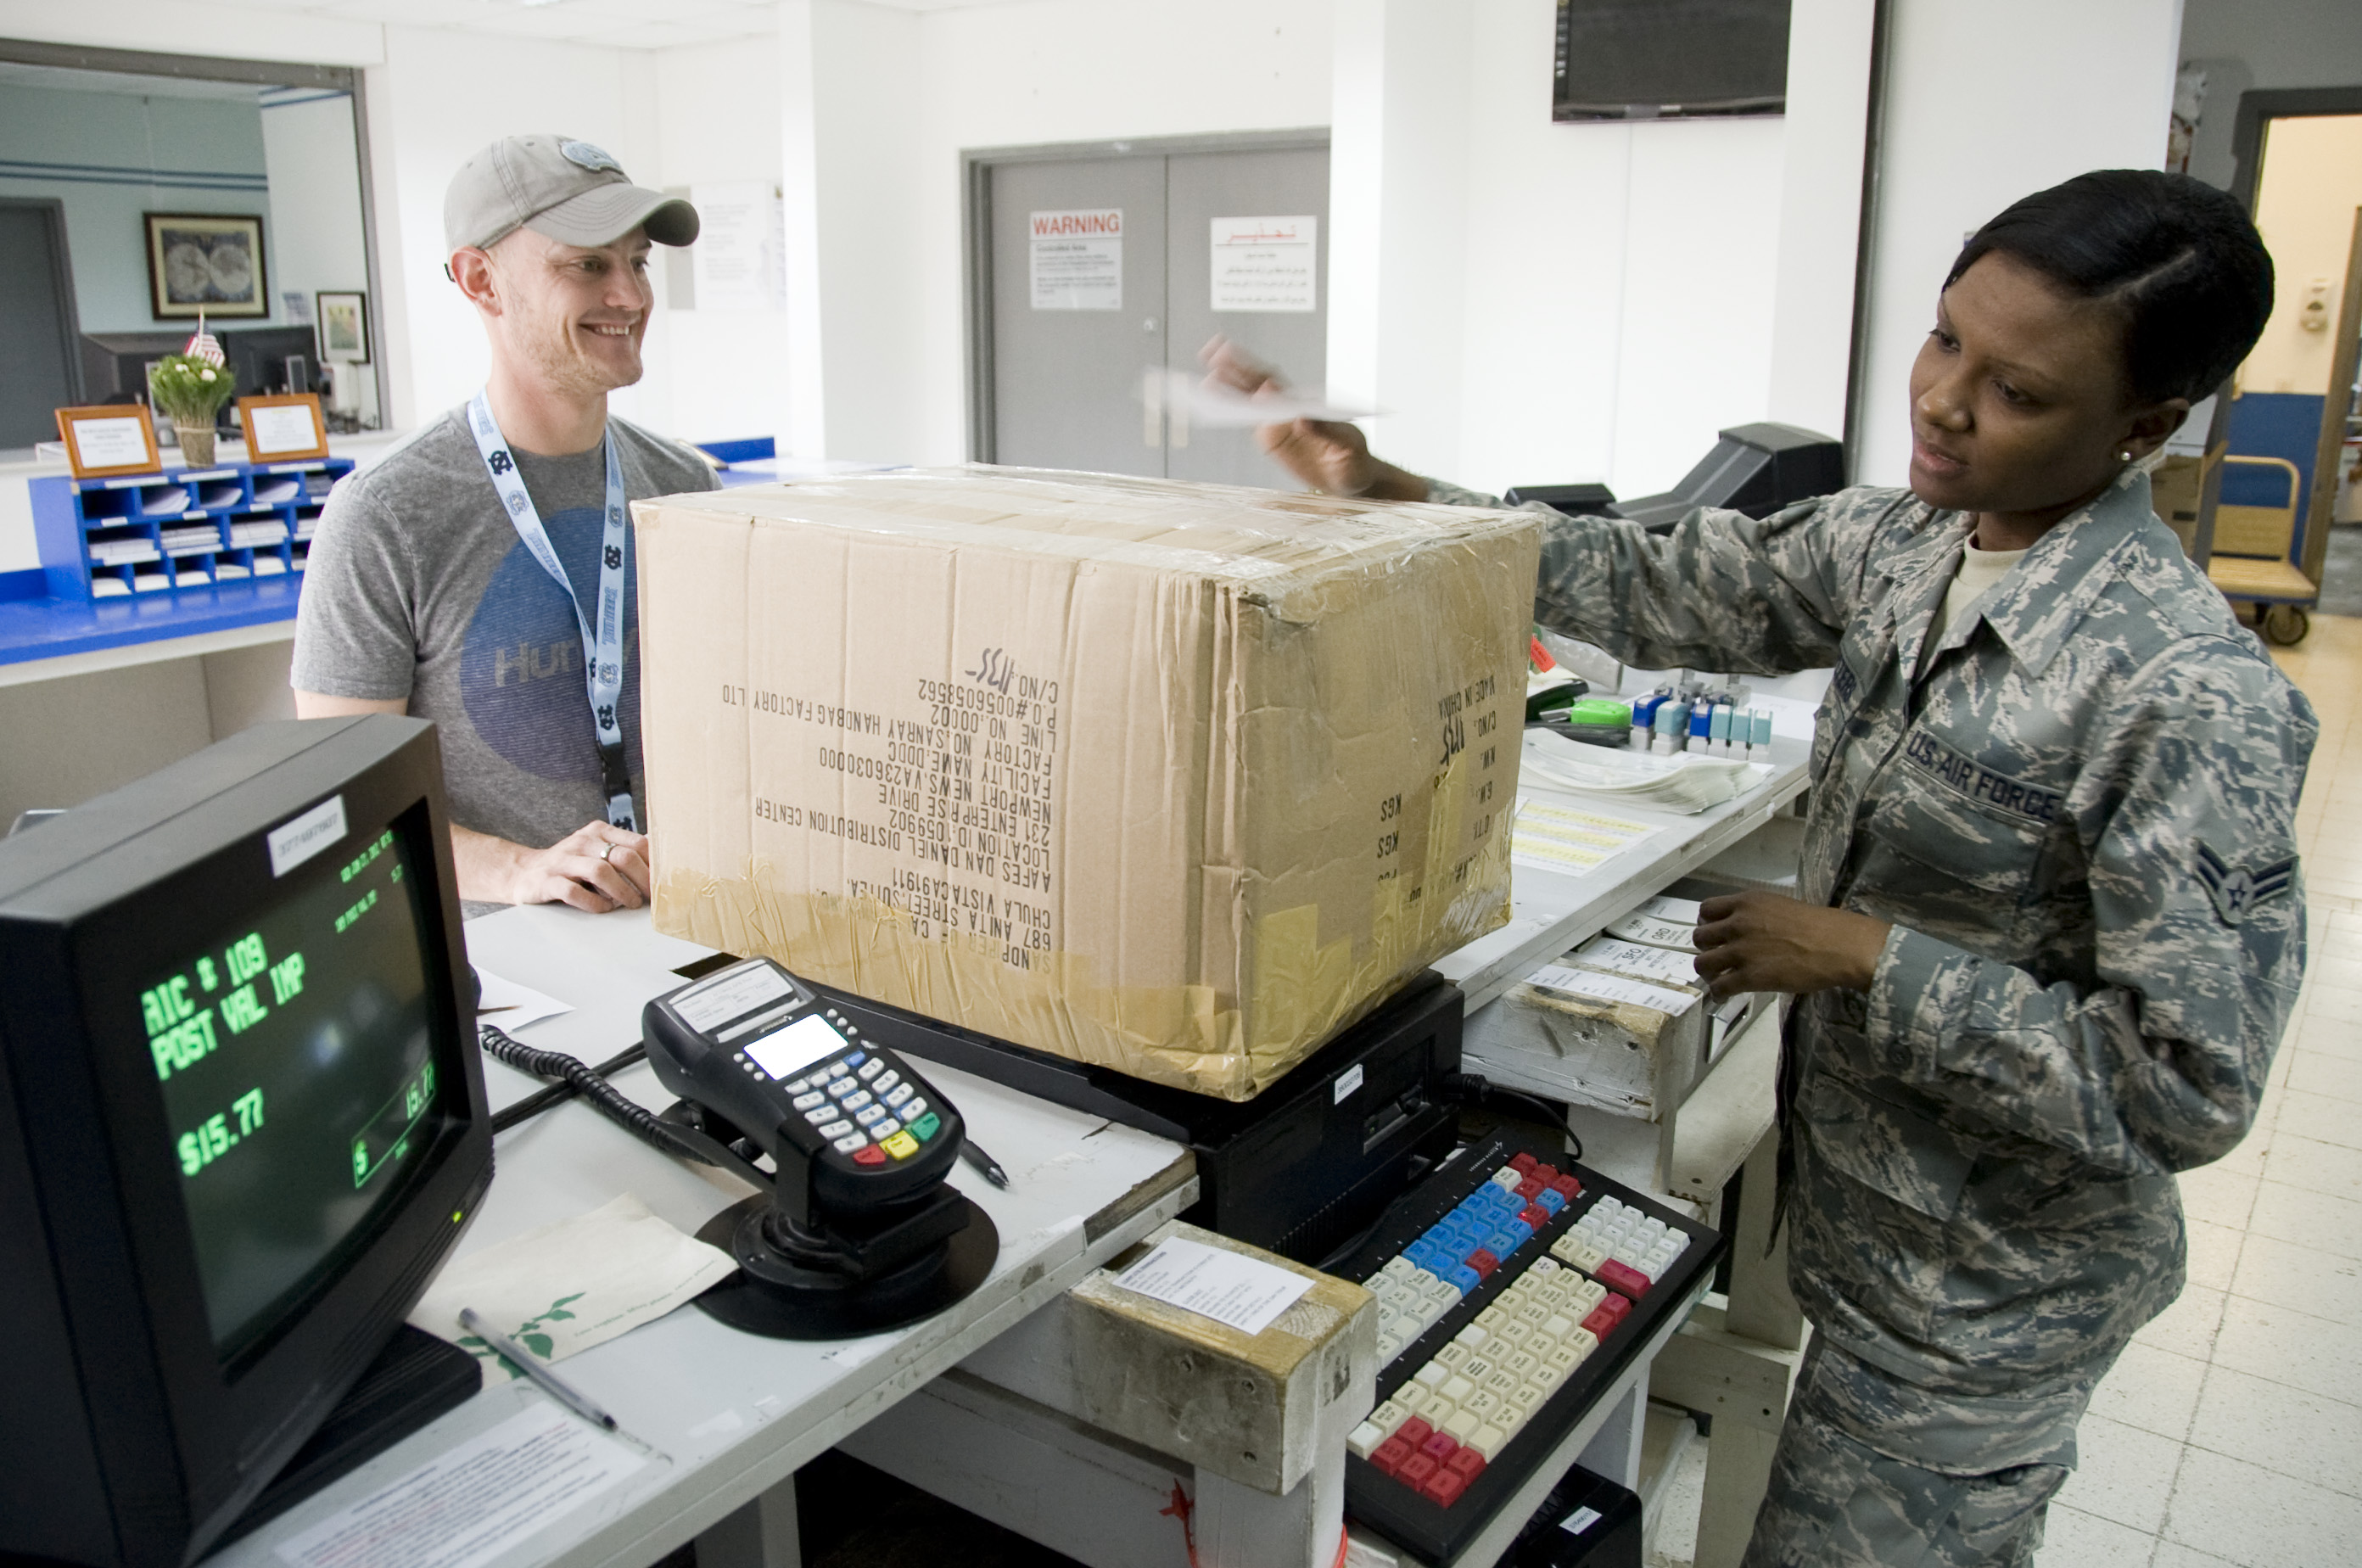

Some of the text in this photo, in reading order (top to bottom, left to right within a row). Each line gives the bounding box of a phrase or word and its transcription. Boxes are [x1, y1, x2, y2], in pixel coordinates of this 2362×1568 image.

[1033, 213, 1119, 236] WARNING
[722, 684, 745, 707] LTD
[753, 690, 813, 720] FACTORY
[1438, 675, 1495, 720] MADE IN CHINA
[817, 704, 880, 736] HANDBAG
[1021, 724, 1056, 752] LINE
[984, 740, 1052, 776] FACTORY
[982, 762, 1050, 799] FACILITY
[1936, 753, 1973, 791] AIR
[1975, 771, 2062, 821] FORCE
[879, 784, 1050, 845] 231 ENTERPRISE DRIVE
[981, 785, 1050, 824] NEWPORT
[1380, 793, 1402, 821] KGS
[755, 797, 1050, 893] AAFES DAN DANIEL DISTRIBUTION CENTER
[978, 833, 1049, 869] LOCATION
[1376, 830, 1398, 859] KGS
[969, 910, 1011, 942] ANITA
[1005, 899, 1050, 929] CHULA
[1023, 928, 1050, 951] 687
[1652, 928, 1671, 940] ORD
[1622, 948, 1642, 960] SFO
[141, 974, 195, 1037] AIC
[226, 932, 268, 987] 109
[150, 952, 305, 1080] POST VAL IMP
[176, 1088, 266, 1177] $15.77
